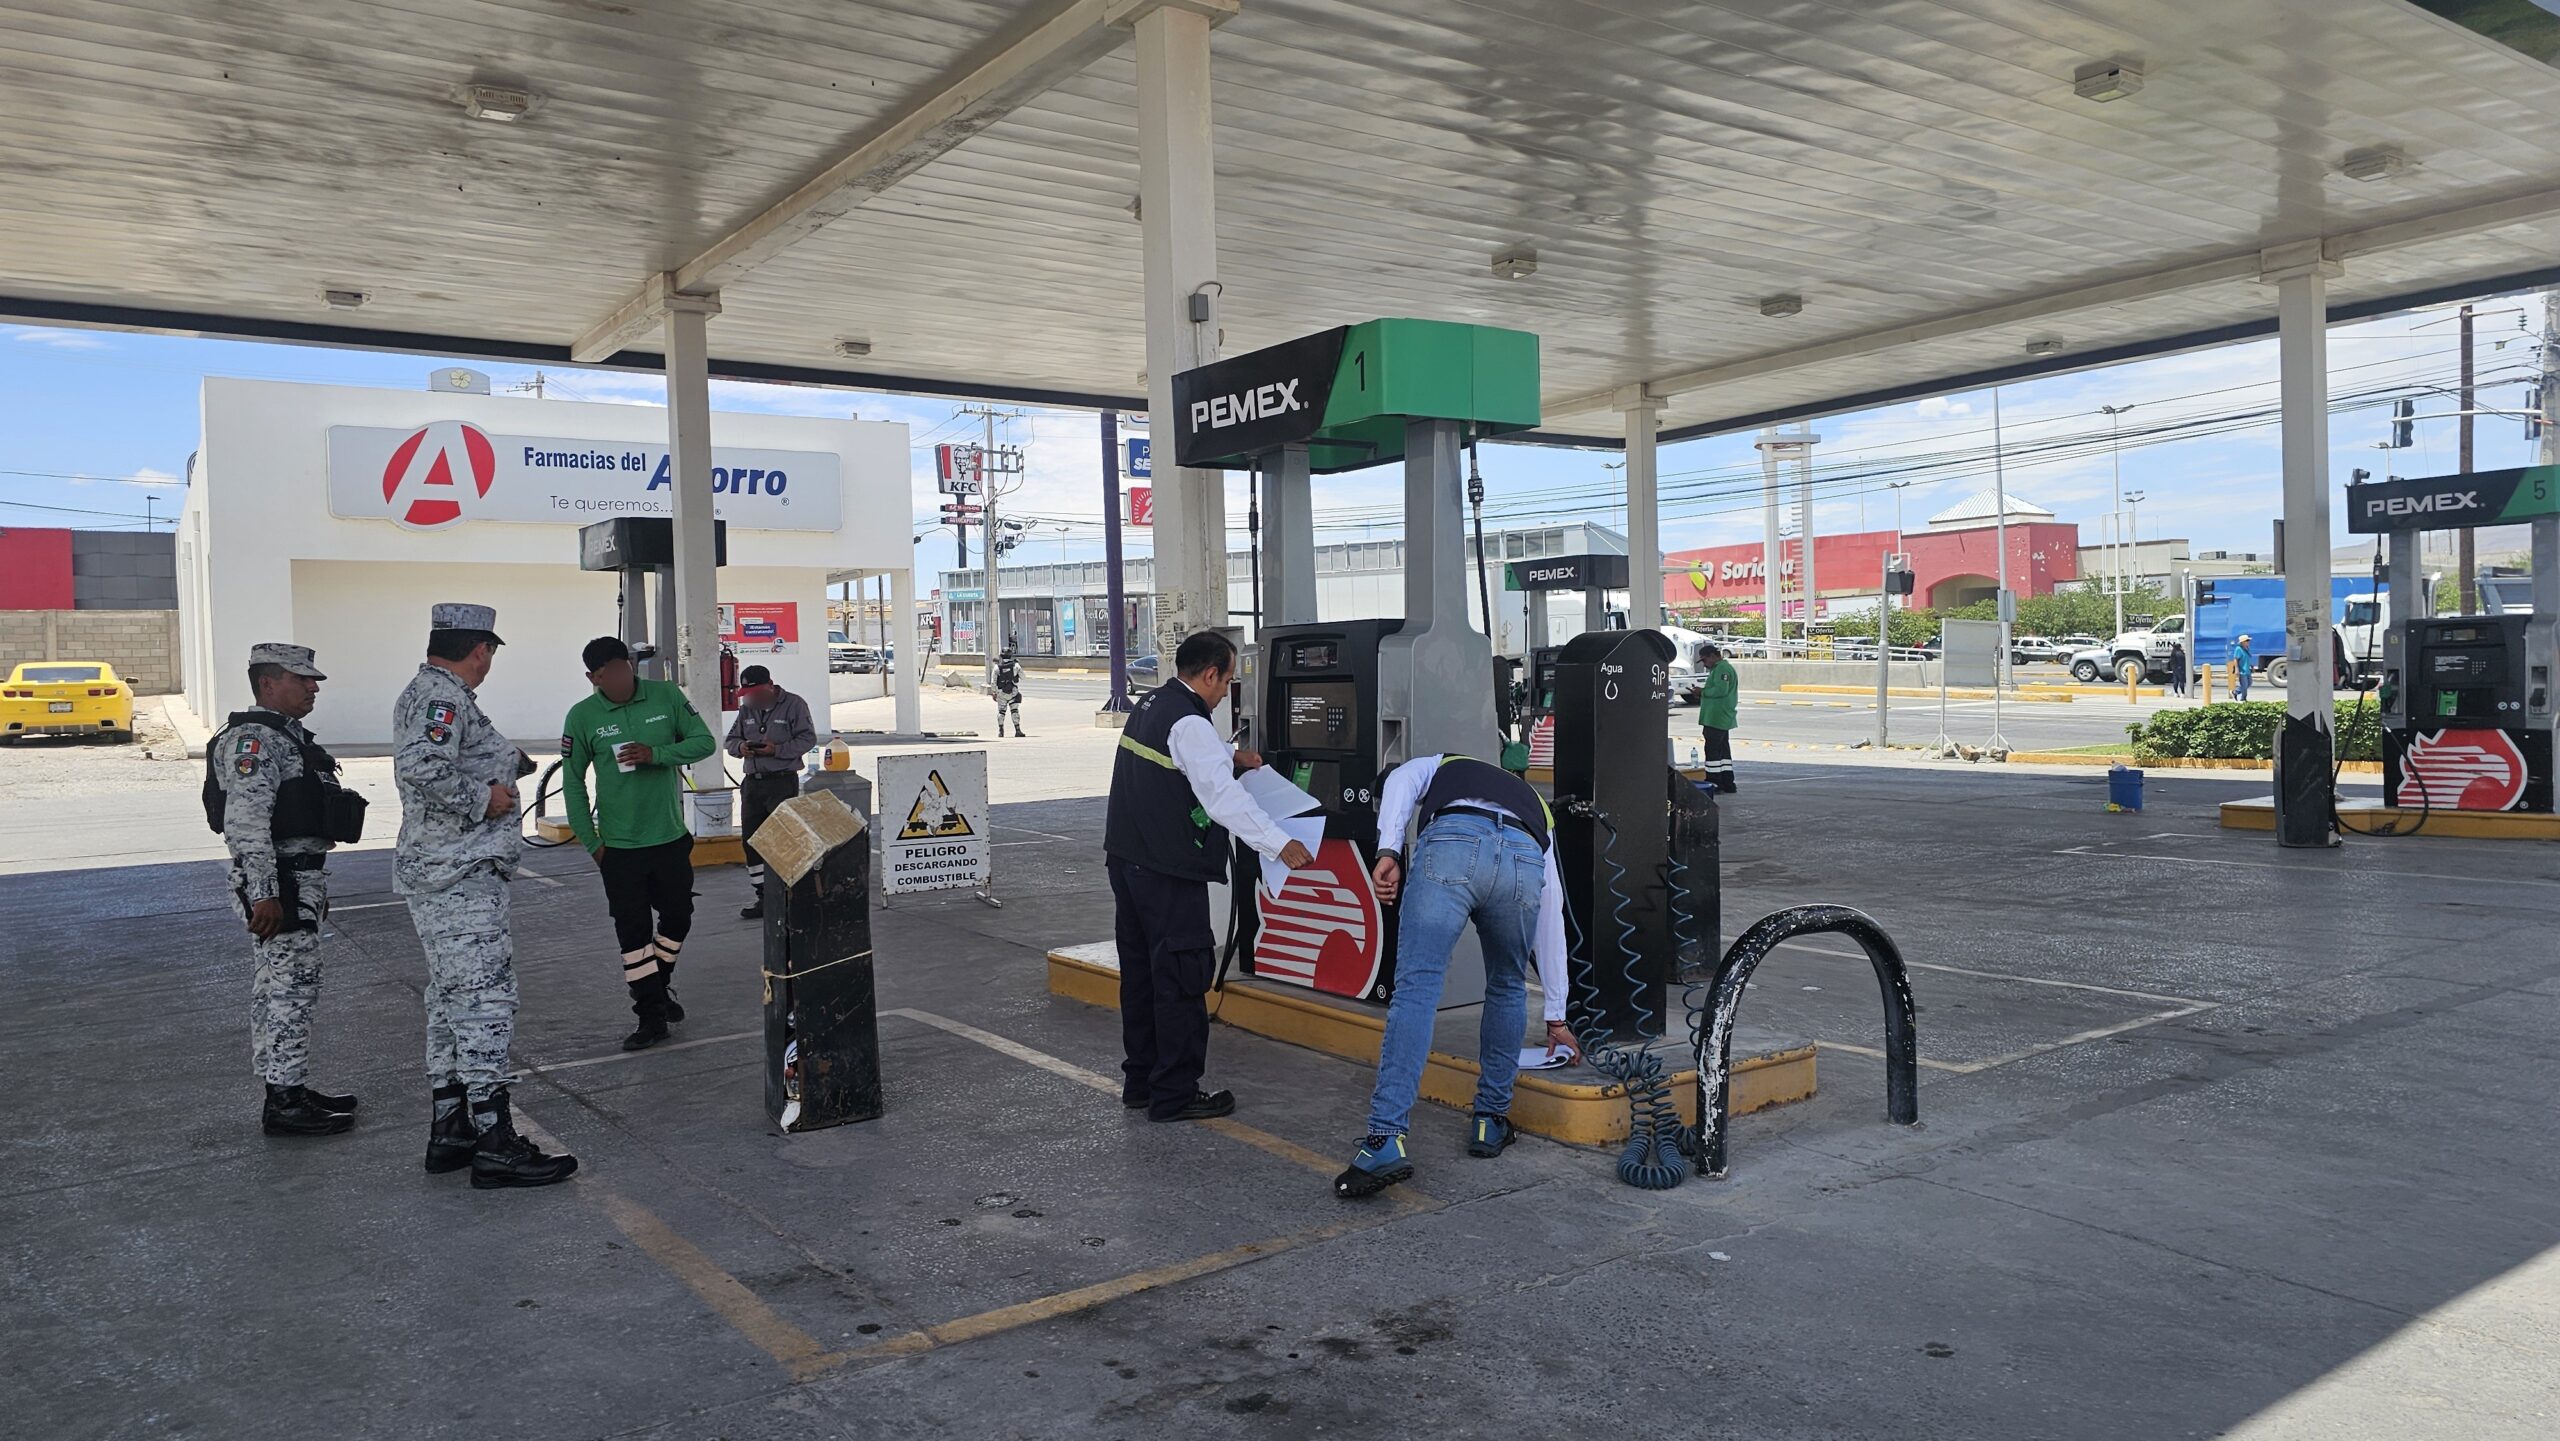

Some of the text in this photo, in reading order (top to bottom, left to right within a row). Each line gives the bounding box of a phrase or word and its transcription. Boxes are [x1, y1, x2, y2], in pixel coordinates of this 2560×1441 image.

[1355, 351, 1365, 391] 1
[1191, 378, 1301, 433] PEMEX
[524, 446, 788, 496] Farmacias del Aorro
[949, 482, 977, 492] KFC
[2534, 479, 2546, 500] 5
[550, 495, 569, 509] Te
[2367, 491, 2478, 517] PEMEX
[1529, 566, 1575, 582] PEMEX
[1721, 556, 1795, 581] Soriaa
[1506, 571, 1512, 583] 7
[1600, 662, 1623, 675] Agua
[905, 845, 967, 859] PELIGRO
[894, 858, 978, 872] DESCARGANDO
[897, 872, 976, 886] COMBUSTIBLE
